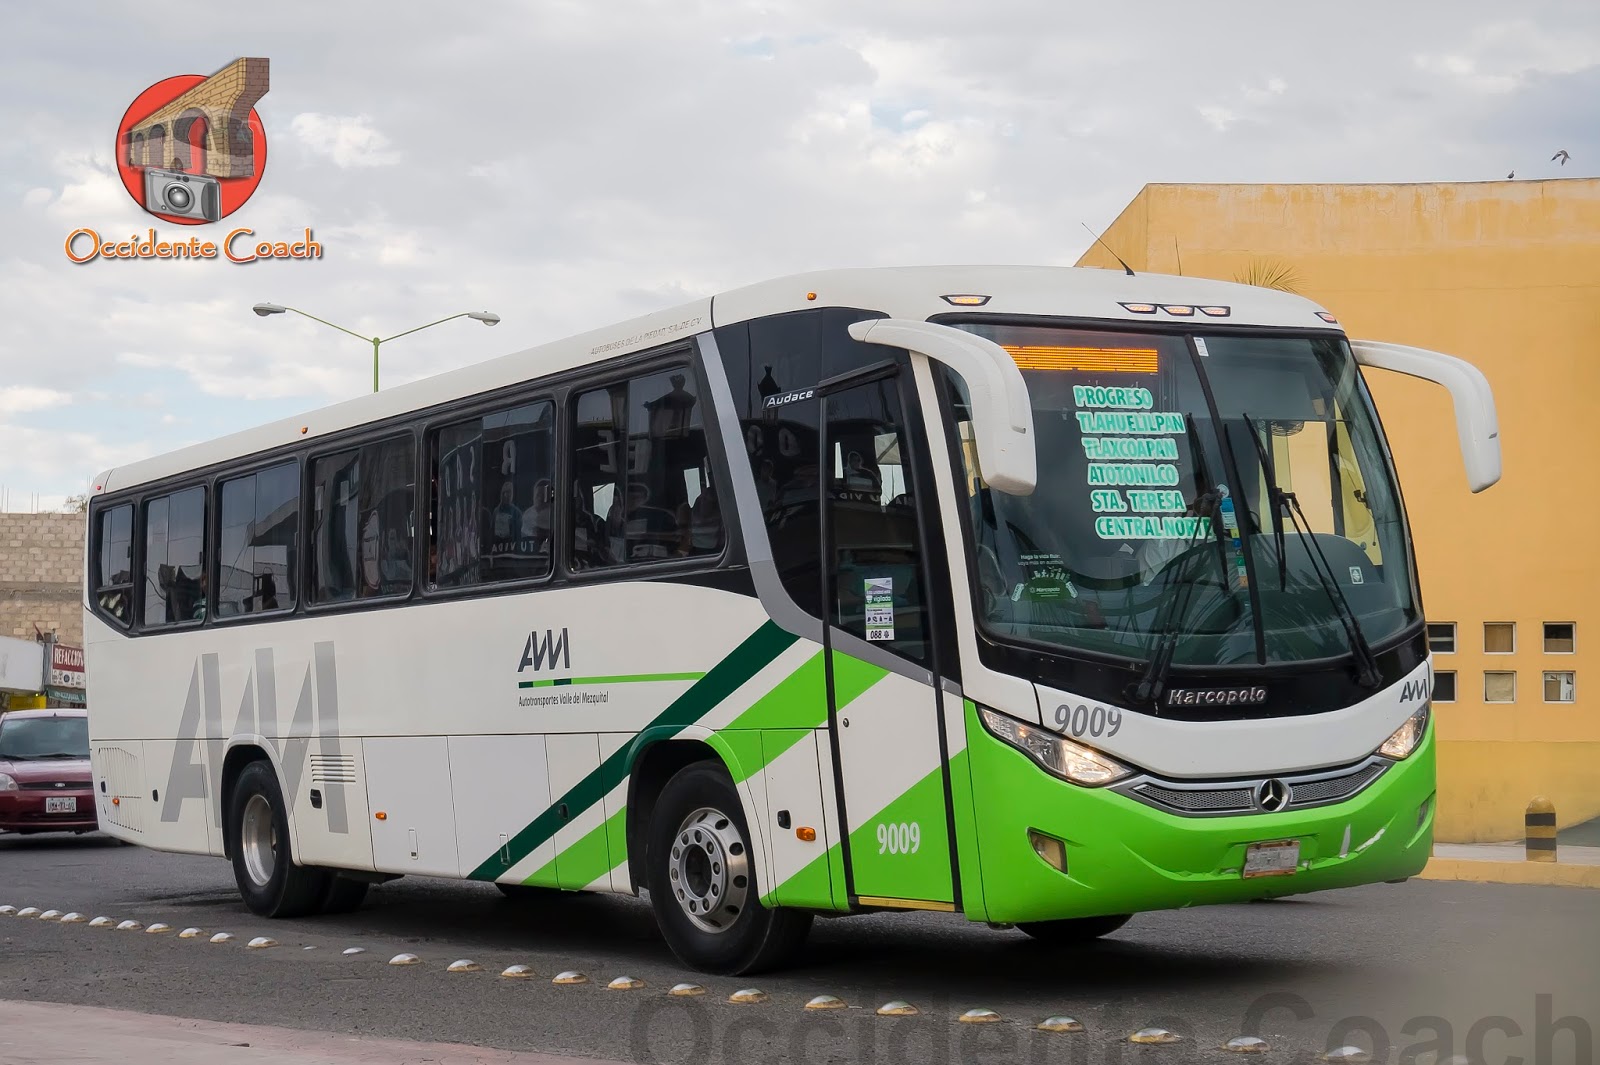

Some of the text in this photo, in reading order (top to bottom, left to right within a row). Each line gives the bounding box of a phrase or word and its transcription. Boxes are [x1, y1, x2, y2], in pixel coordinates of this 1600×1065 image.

[591, 340, 625, 355] AUTOBUSES
[766, 390, 814, 407] Audace
[1074, 386, 1153, 408] PROGRESO
[1077, 412, 1185, 433] TLAHUELILPAN
[1082, 438, 1178, 459] TLAXCOAPAN
[1089, 464, 1178, 485] ATOTONILCO
[1092, 491, 1186, 511] STA. TERESA
[1096, 517, 1162, 538] CENTRAL
[519, 690, 609, 708] Autotransportes Valle del Mezquital
[1168, 687, 1266, 705] Marcopolo
[1055, 704, 1122, 738] 9009
[877, 822, 920, 854] 9009
